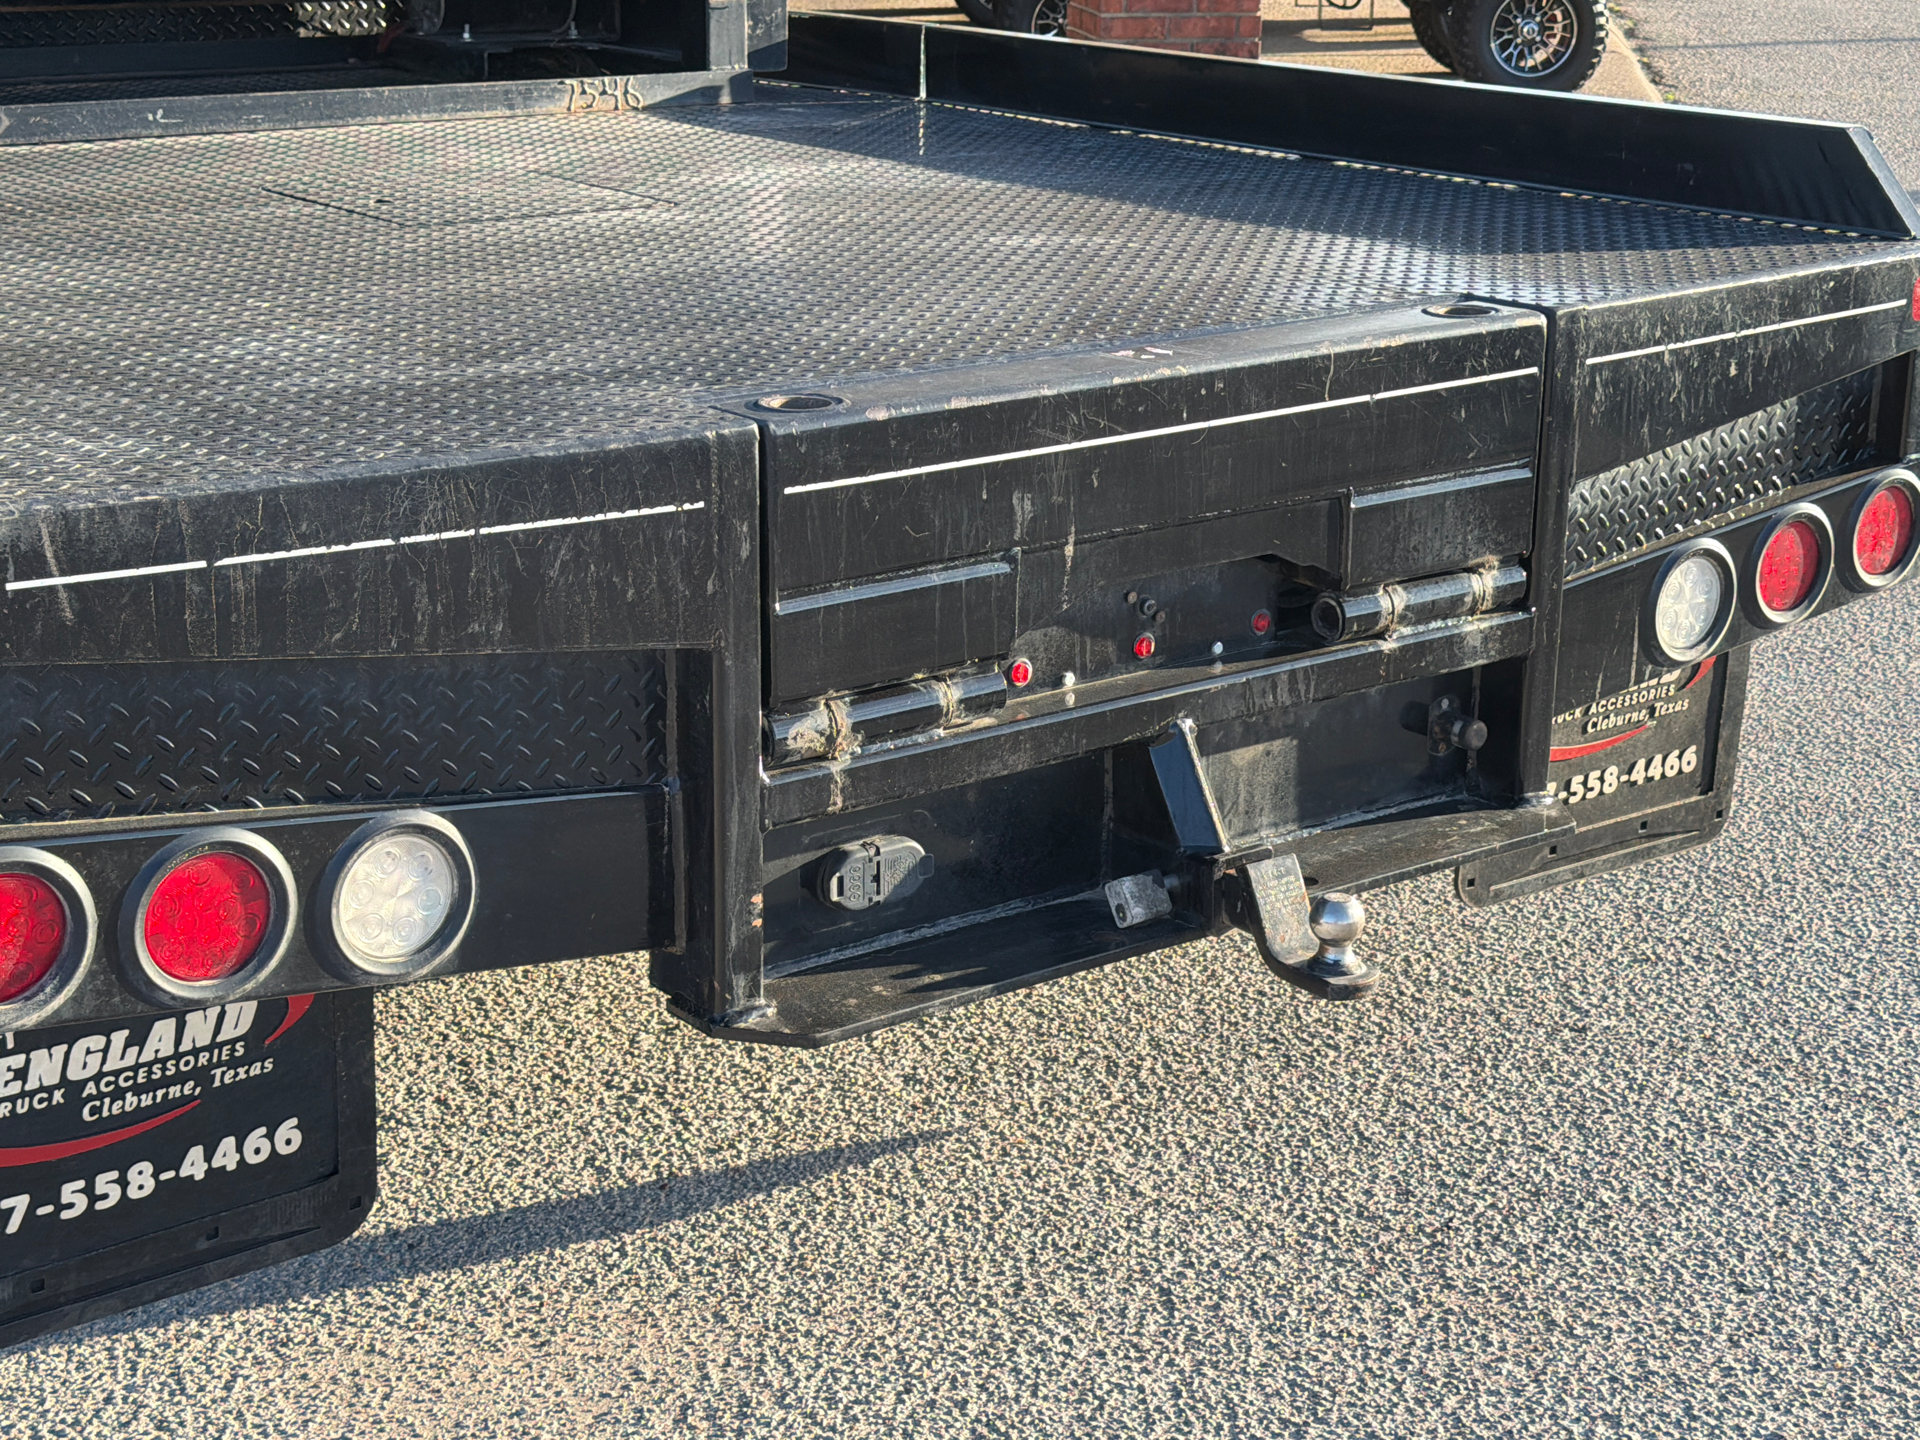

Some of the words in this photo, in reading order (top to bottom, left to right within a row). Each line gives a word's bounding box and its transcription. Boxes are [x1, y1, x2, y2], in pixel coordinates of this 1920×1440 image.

[560, 76, 644, 113] 7546
[1586, 709, 1650, 734] Cleburne,
[1653, 698, 1690, 718] Texas
[1588, 684, 1675, 715] ACCESSORIES
[0, 1000, 259, 1099] ENGLAND
[82, 1041, 246, 1099] ACCESSORIES
[82, 1078, 203, 1123] Cleburne,
[210, 1057, 275, 1089] Texas
[0, 1116, 303, 1235] 7-558-4466
